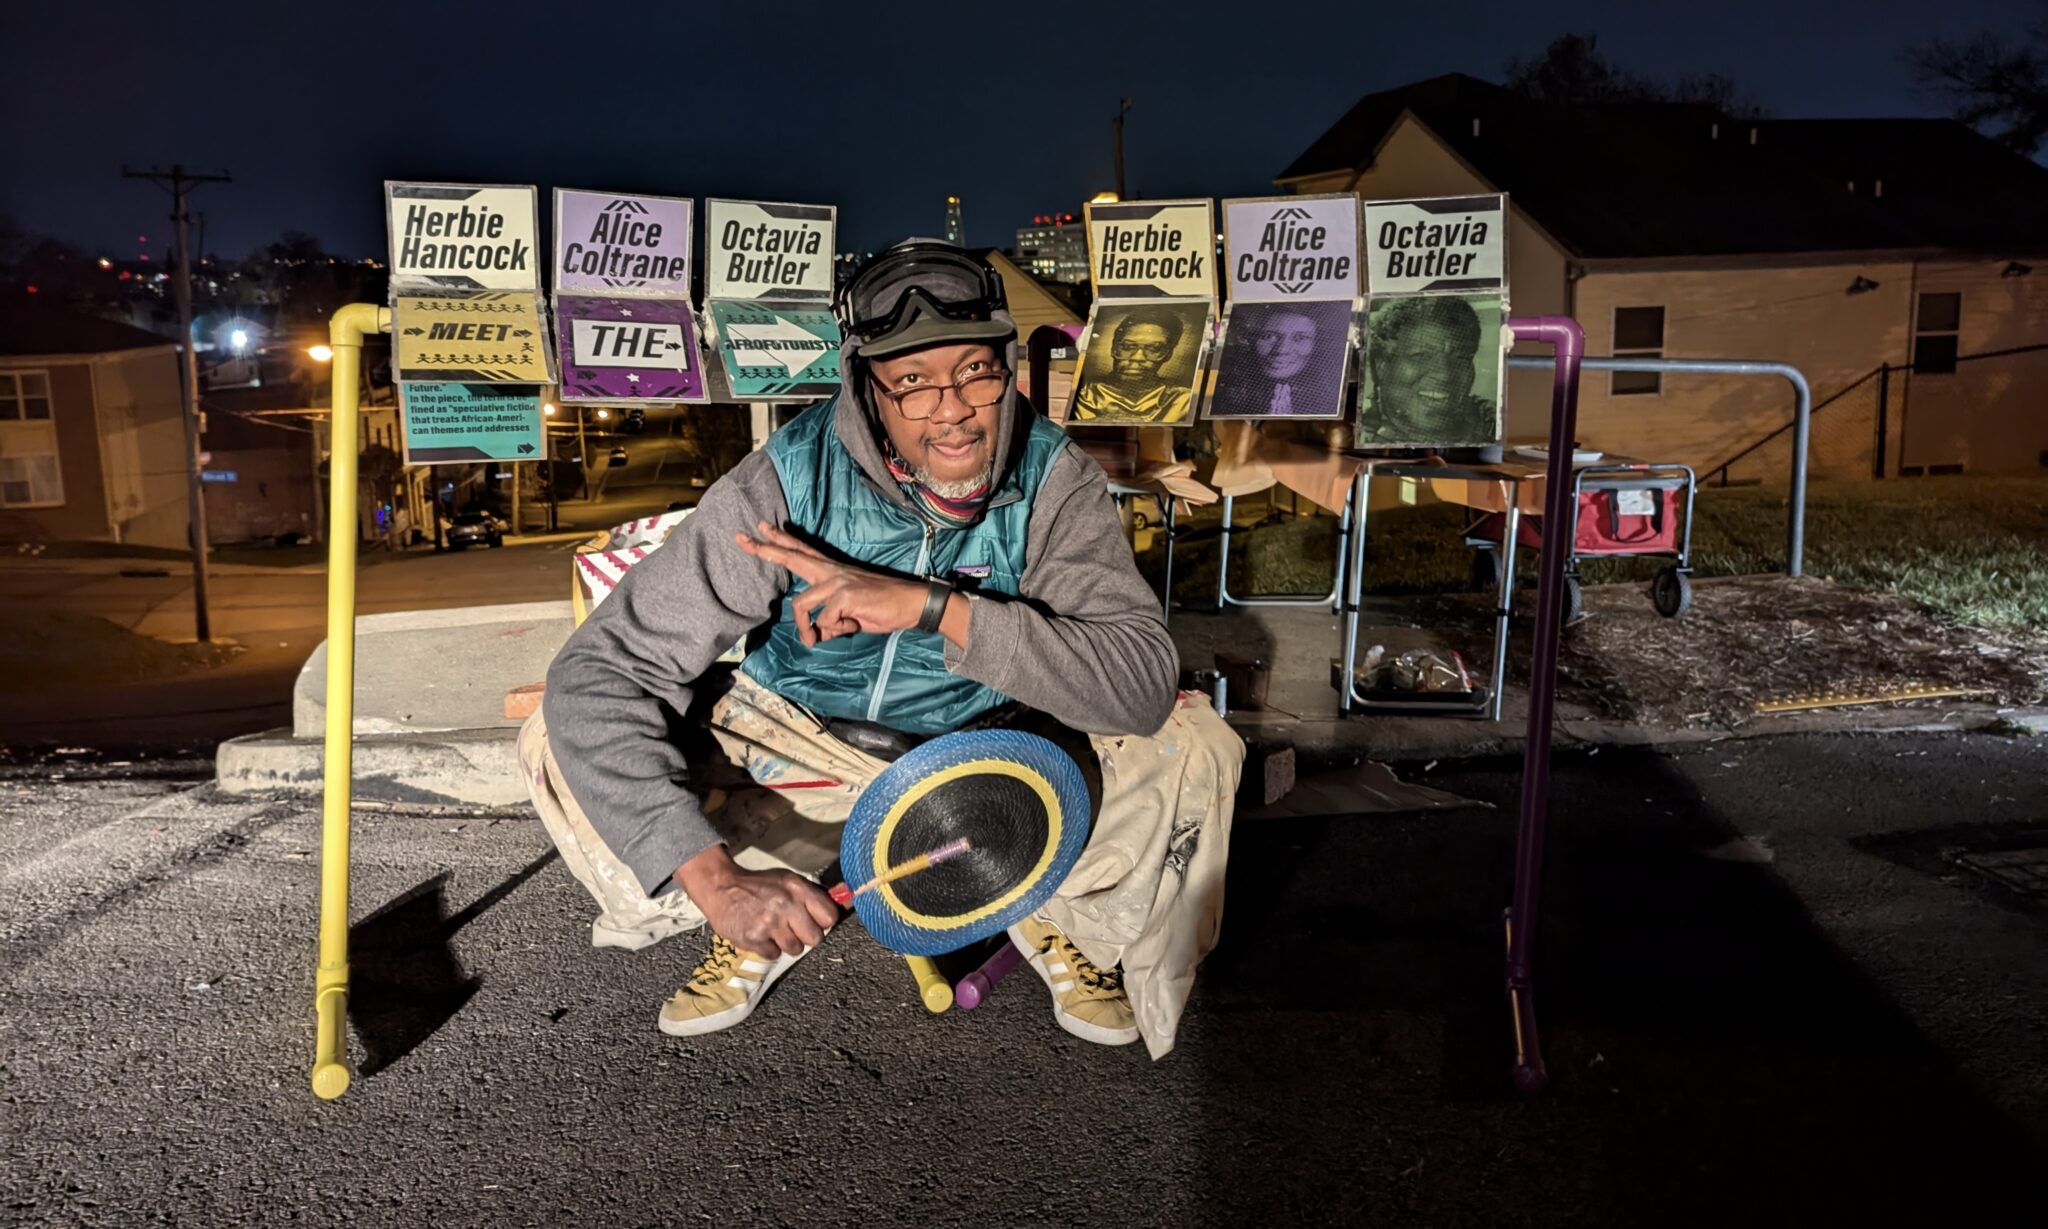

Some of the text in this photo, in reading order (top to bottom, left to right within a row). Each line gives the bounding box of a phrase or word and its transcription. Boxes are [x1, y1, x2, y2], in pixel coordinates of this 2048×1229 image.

[404, 204, 504, 239] Herbie
[589, 212, 663, 248] Alice
[721, 219, 821, 255] Octavia
[1258, 220, 1327, 252] Alice
[1378, 216, 1488, 250] Octavia
[1103, 223, 1182, 253] Herbie
[399, 237, 530, 271] Hancock
[563, 242, 685, 282] Coltrane
[726, 251, 810, 285] Butler
[1099, 251, 1205, 280] Hancock
[1237, 252, 1351, 283] Coltrane
[1386, 249, 1477, 279] Butler
[427, 322, 513, 342] MEET
[591, 325, 667, 359] THE
[726, 338, 840, 351] AFROFUTURISTS
[410, 394, 419, 403] In
[420, 394, 437, 403] the
[438, 394, 466, 404] piece,
[411, 405, 434, 414] fined
[449, 403, 505, 414] "speculative
[411, 415, 430, 424] that
[432, 414, 459, 423] treats
[412, 423, 530, 435] can themes and addresses
